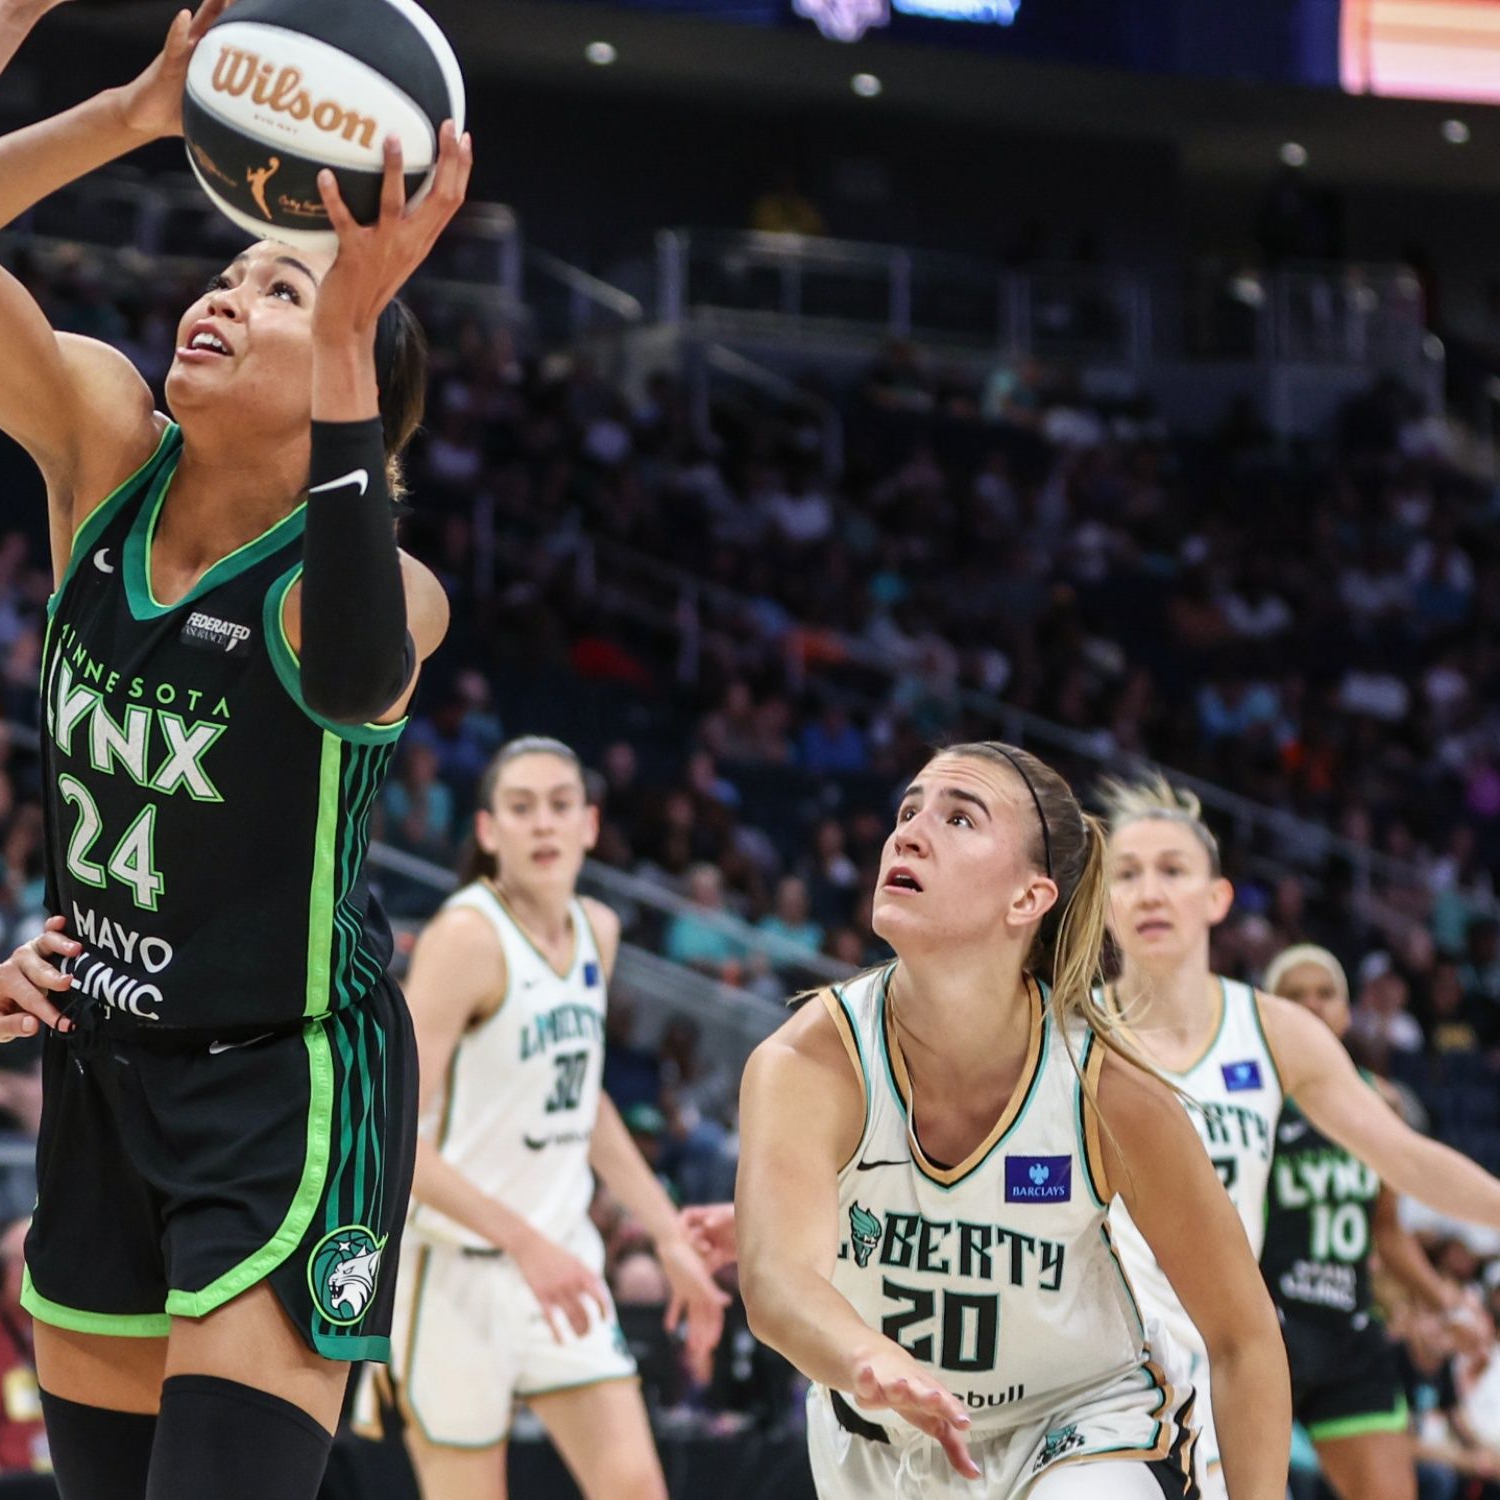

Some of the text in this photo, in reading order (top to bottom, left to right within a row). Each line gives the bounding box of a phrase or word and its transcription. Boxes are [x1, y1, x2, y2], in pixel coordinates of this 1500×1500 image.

[211, 44, 378, 151] Wilson
[186, 611, 251, 640] FEDERATED
[58, 772, 165, 912] 24
[72, 900, 173, 974] MAYO
[1012, 1185, 1066, 1198] BARCLAYS
[1311, 1201, 1368, 1263] 10
[837, 1199, 1066, 1292] IBERTY
[881, 1275, 1001, 1374] 20
